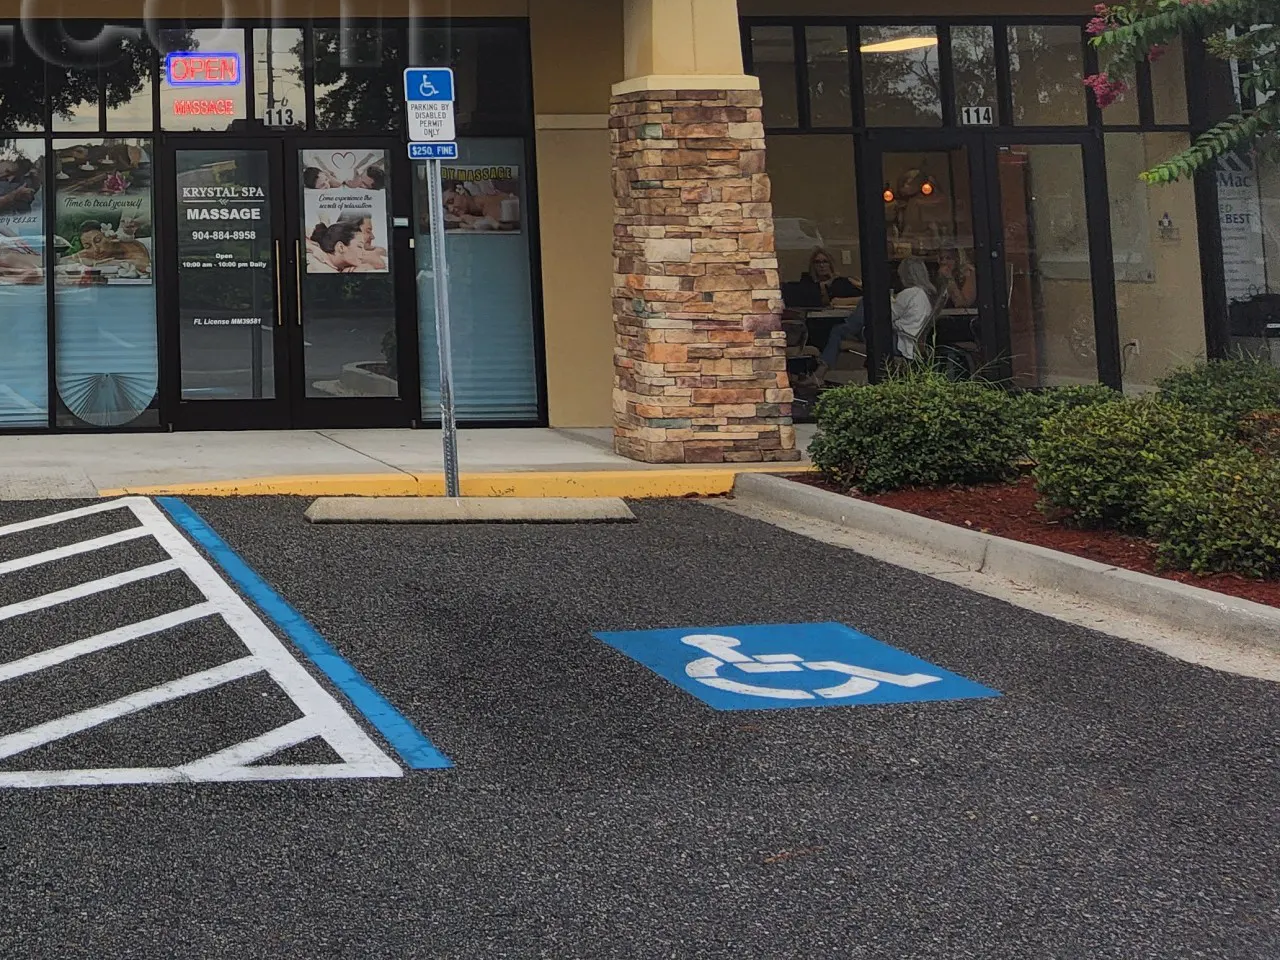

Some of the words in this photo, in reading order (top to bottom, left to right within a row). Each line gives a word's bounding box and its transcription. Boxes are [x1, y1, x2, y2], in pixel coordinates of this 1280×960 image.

[171, 58, 237, 81] OPEN
[173, 99, 234, 115] MASSAGE
[266, 109, 293, 125] 113
[964, 108, 991, 123] 114
[423, 128, 440, 136] ONLY
[437, 146, 454, 155] FINE
[457, 167, 512, 182] MASSAGE
[183, 187, 239, 198] KRYSTAL
[241, 187, 264, 197] SPA
[319, 194, 333, 202] Come
[64, 197, 83, 208] Time
[84, 198, 92, 207] to
[93, 198, 113, 207] treat
[112, 198, 143, 211] yourself
[186, 208, 261, 220] MASSAGE
[192, 231, 256, 240] 904-884-8958
